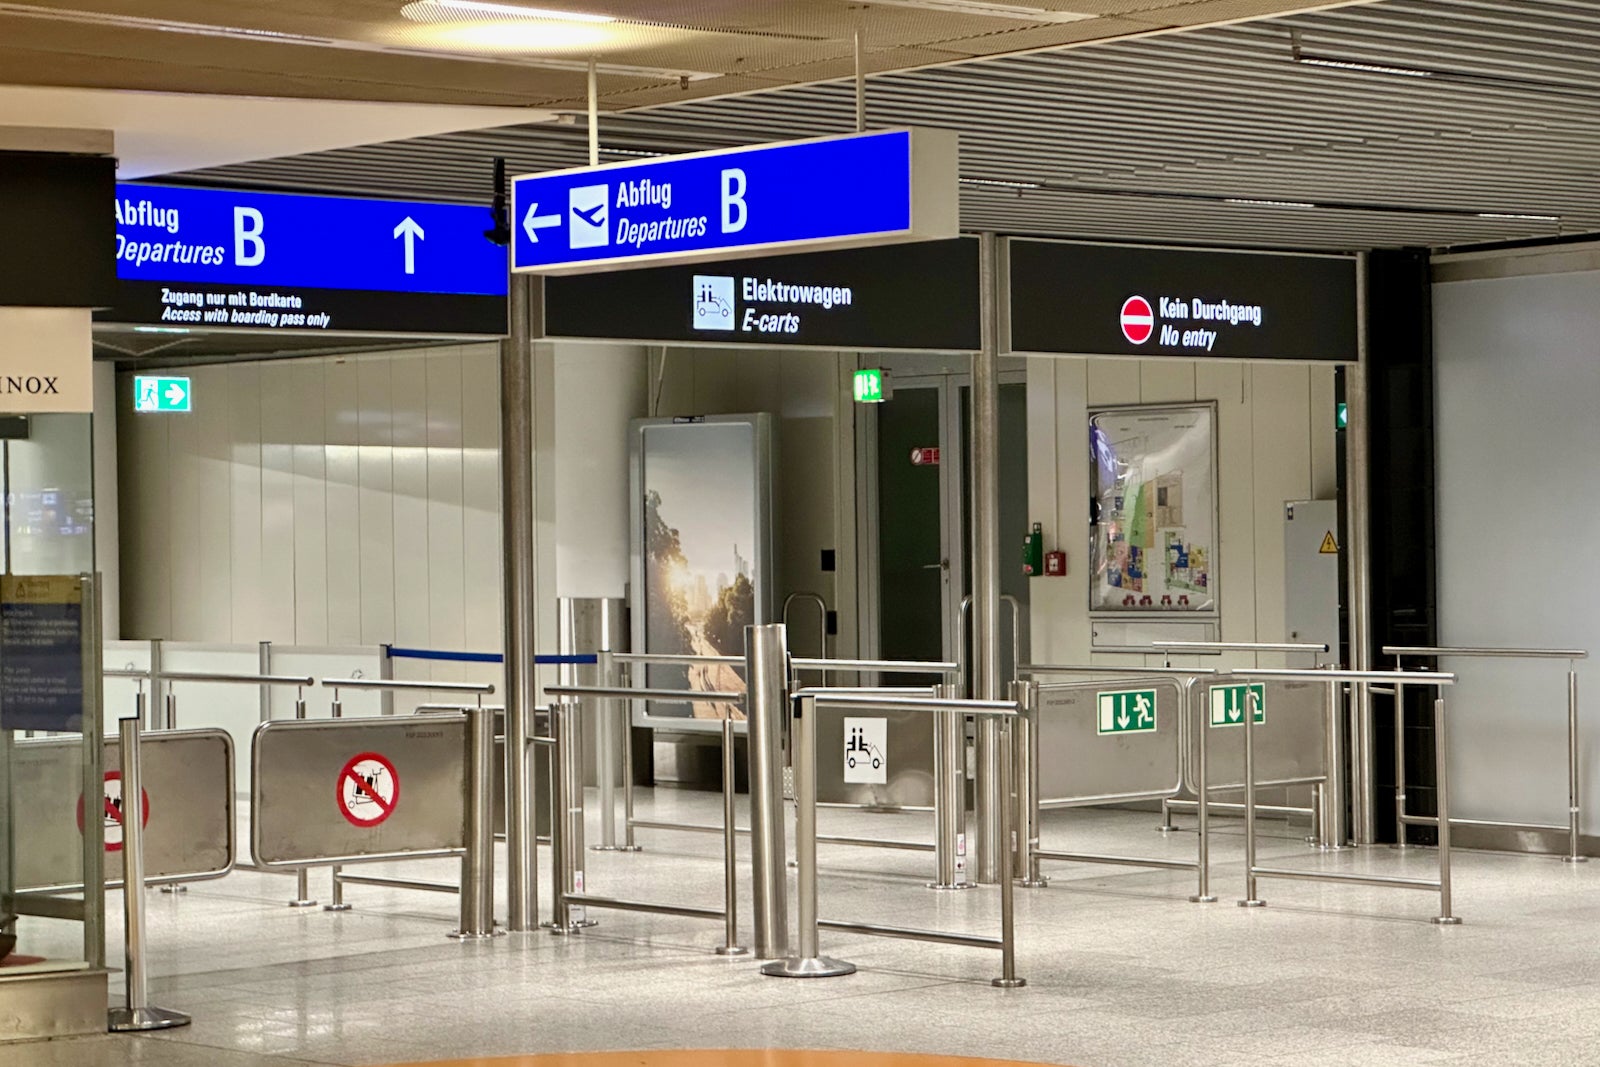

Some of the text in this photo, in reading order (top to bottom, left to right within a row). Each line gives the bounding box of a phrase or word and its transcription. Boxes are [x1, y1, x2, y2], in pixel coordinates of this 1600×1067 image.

[616, 179, 671, 209] Abflug
[721, 168, 747, 233] B
[233, 206, 266, 267] B
[616, 216, 707, 248] Departures
[161, 289, 302, 308] Zugang nur mit Bordkarte
[743, 277, 852, 309] Elektrowagen
[162, 306, 331, 329] Access with boarding pass only
[741, 307, 800, 334] E-carts
[1159, 297, 1262, 326] Kein Durchgang
[1159, 325, 1217, 351] No entry
